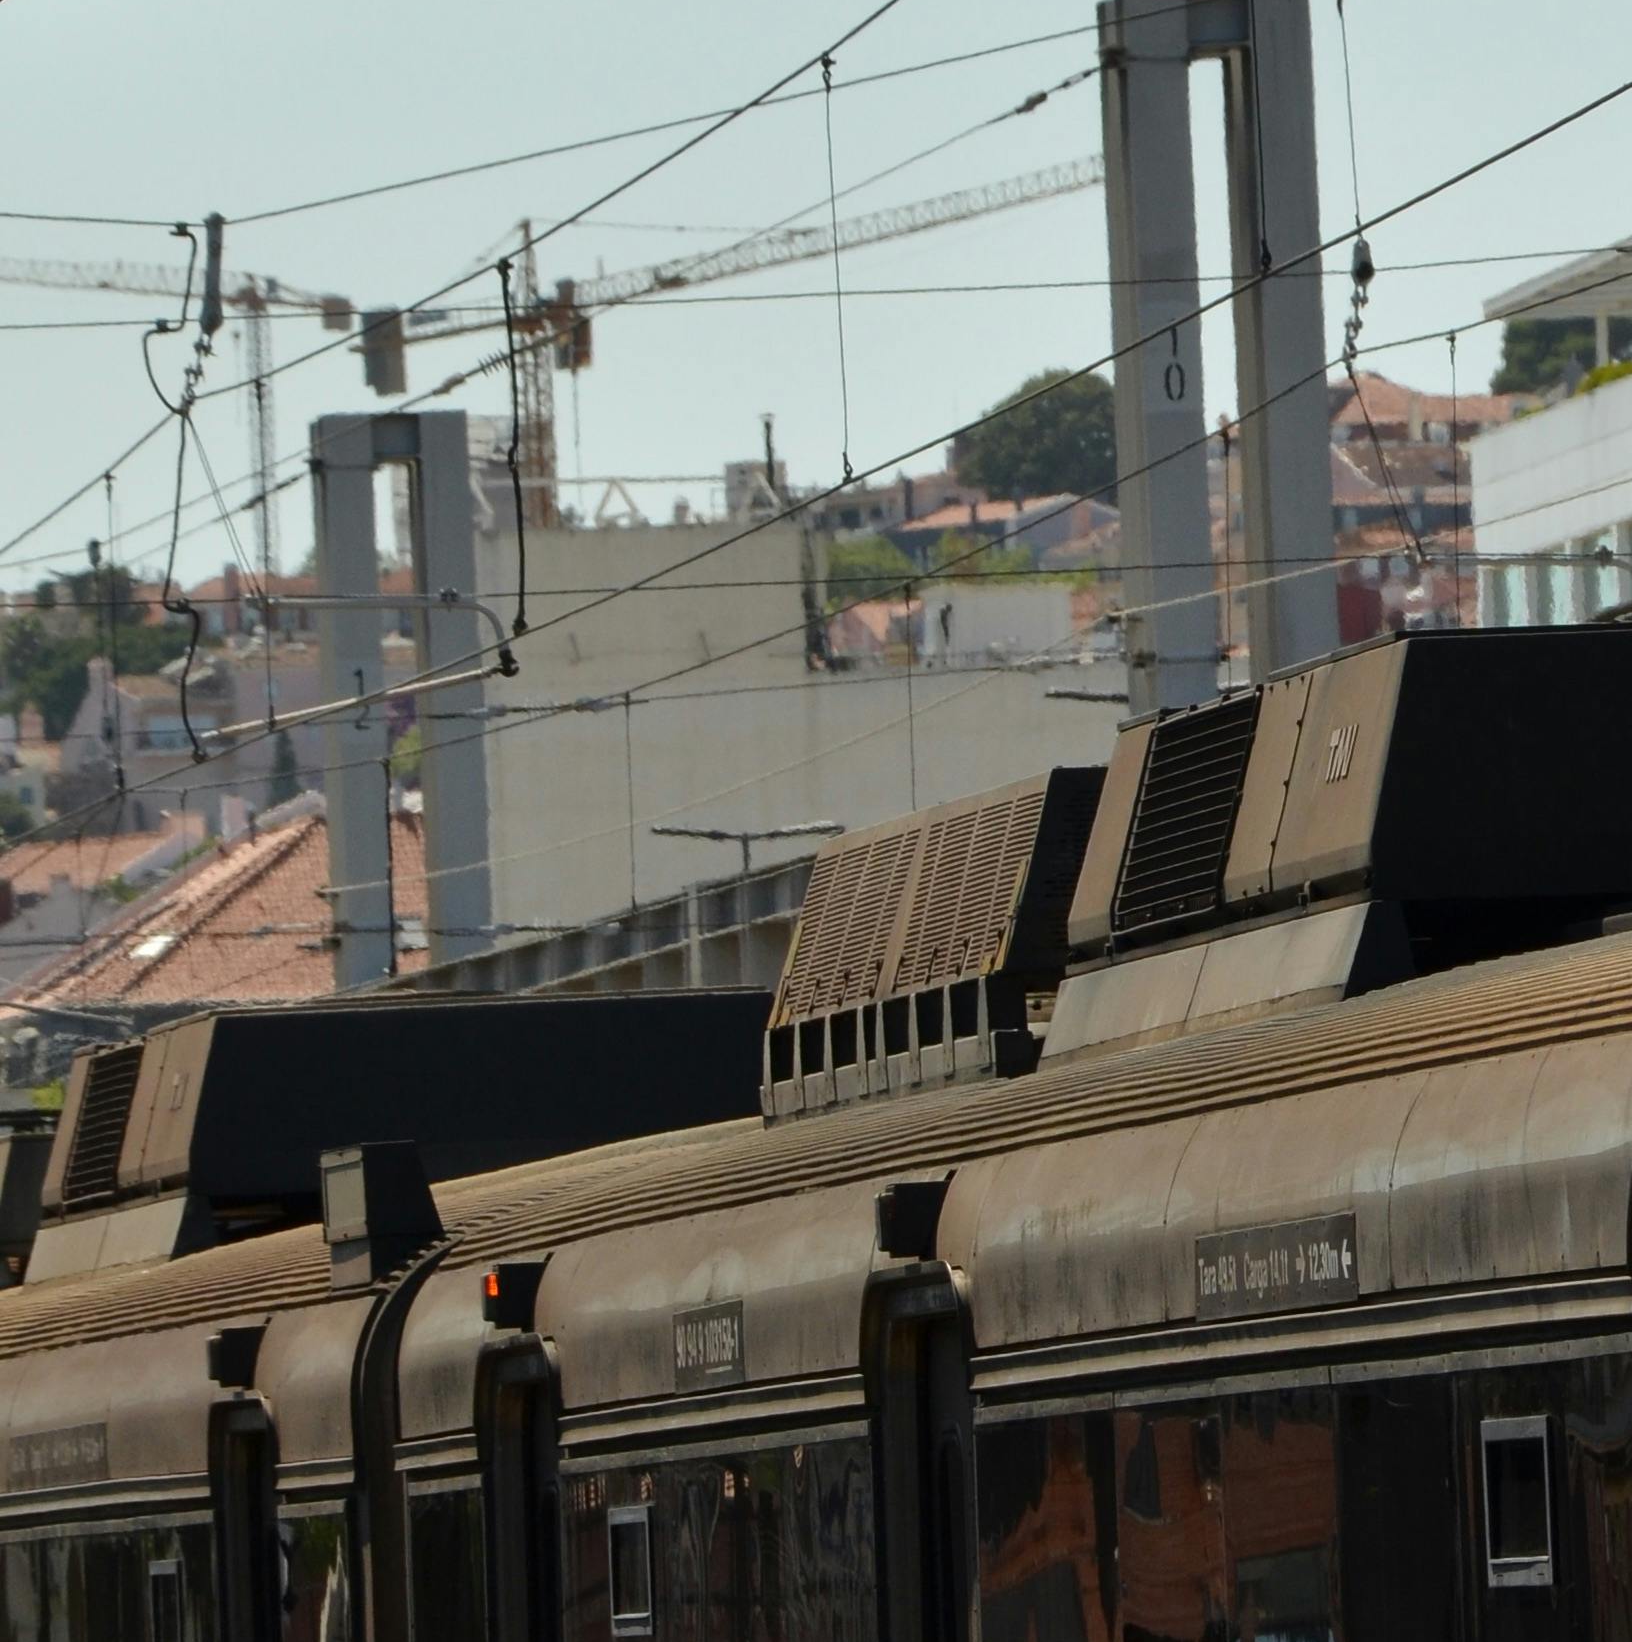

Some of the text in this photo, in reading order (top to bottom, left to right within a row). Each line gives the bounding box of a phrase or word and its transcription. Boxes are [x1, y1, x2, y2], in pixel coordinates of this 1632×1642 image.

[1198, 1258, 1217, 1296] Tara
[1243, 1251, 1269, 1299] Carga
[1308, 1241, 1339, 1288] 12,30m
